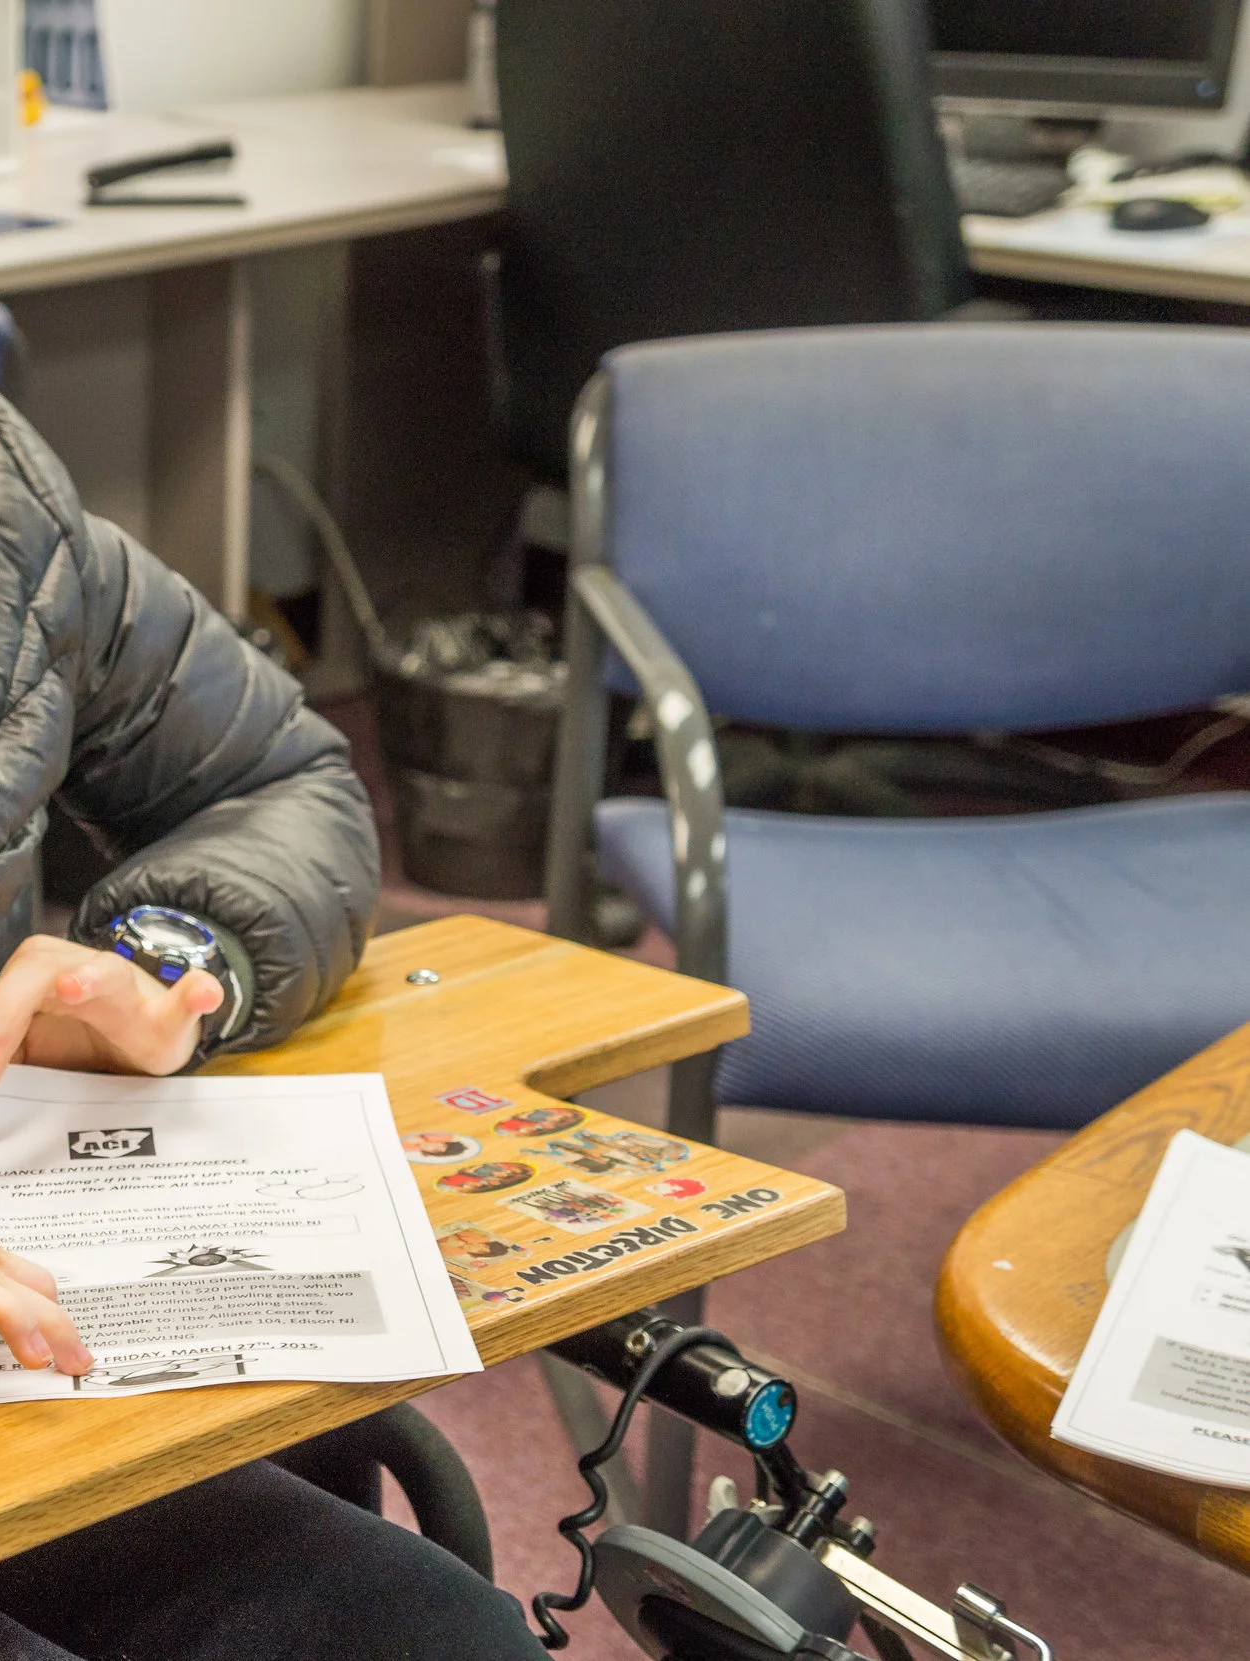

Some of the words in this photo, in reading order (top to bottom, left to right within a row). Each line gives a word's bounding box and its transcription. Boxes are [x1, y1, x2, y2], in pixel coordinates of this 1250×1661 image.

[83, 1139, 131, 1151] ACI
[50, 1165, 104, 1173] CENTER
[108, 1163, 136, 1171] FOR
[140, 1159, 248, 1169] INDEPENDENCE
[36, 1178, 99, 1188] bowling?
[110, 1183, 165, 1191] Alliance
[701, 1188, 780, 1219] ONE
[9, 1213, 58, 1222] evening
[174, 1203, 213, 1212] plenty
[108, 1215, 153, 1223] Stelton
[197, 1210, 247, 1218] Bowling
[20, 1233, 77, 1242] STELTON
[144, 1222, 228, 1233] PISCATAWAY
[232, 1220, 302, 1228] TOWNSHIP
[121, 1235, 153, 1243] 2015
[157, 1233, 196, 1241] FROM
[516, 1216, 698, 1284] DIRECTION
[84, 1284, 133, 1294] register
[138, 1281, 168, 1289] with
[209, 1274, 265, 1284] Ghanem
[270, 1272, 362, 1281] 732-738-4388
[223, 1285, 245, 1293] per
[249, 1283, 299, 1291] person,
[151, 1296, 216, 1305] unlimited
[220, 1291, 273, 1300] bowling
[276, 1291, 324, 1299] games,
[103, 1309, 160, 1318] fountain
[163, 1305, 208, 1313] drinks,
[227, 1300, 281, 1309] bowling
[99, 1318, 153, 1328] payable
[208, 1309, 262, 1319] Alliance
[95, 1329, 151, 1338] Avenue,
[175, 1322, 213, 1331] Floor,
[217, 1319, 253, 1327] Suite
[290, 1317, 335, 1325] Edison
[127, 1334, 198, 1344] BOWLING.
[104, 1351, 166, 1363] FRIDAY,
[171, 1345, 231, 1356] MARCH
[280, 1342, 324, 1350] 2015.
